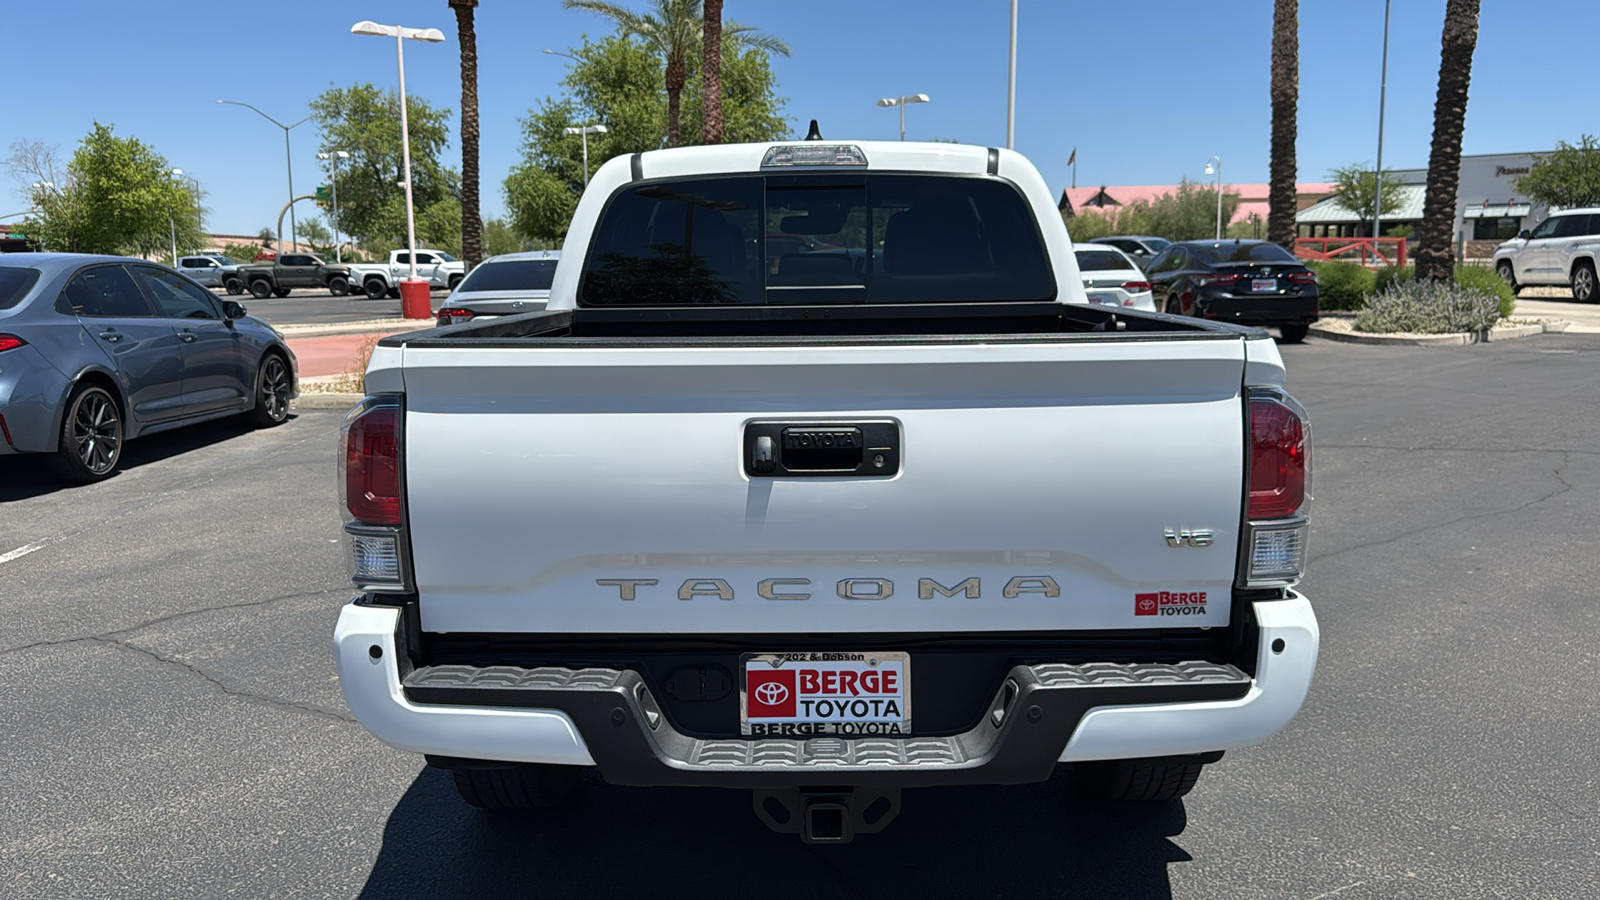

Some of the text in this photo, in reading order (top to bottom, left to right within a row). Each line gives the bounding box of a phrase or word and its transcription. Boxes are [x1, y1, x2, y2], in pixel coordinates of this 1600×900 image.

[788, 432, 857, 448] TOYOTA
[1164, 528, 1214, 548] V6
[595, 575, 1061, 601] TACOMA
[1159, 591, 1207, 605] BERGE
[1159, 606, 1206, 616] TOYOTA
[785, 653, 865, 661] 202 & Dobson
[799, 669, 898, 697] BERGE
[800, 700, 901, 717] TOYOTA
[751, 722, 901, 735] BERGE TOYOTA
